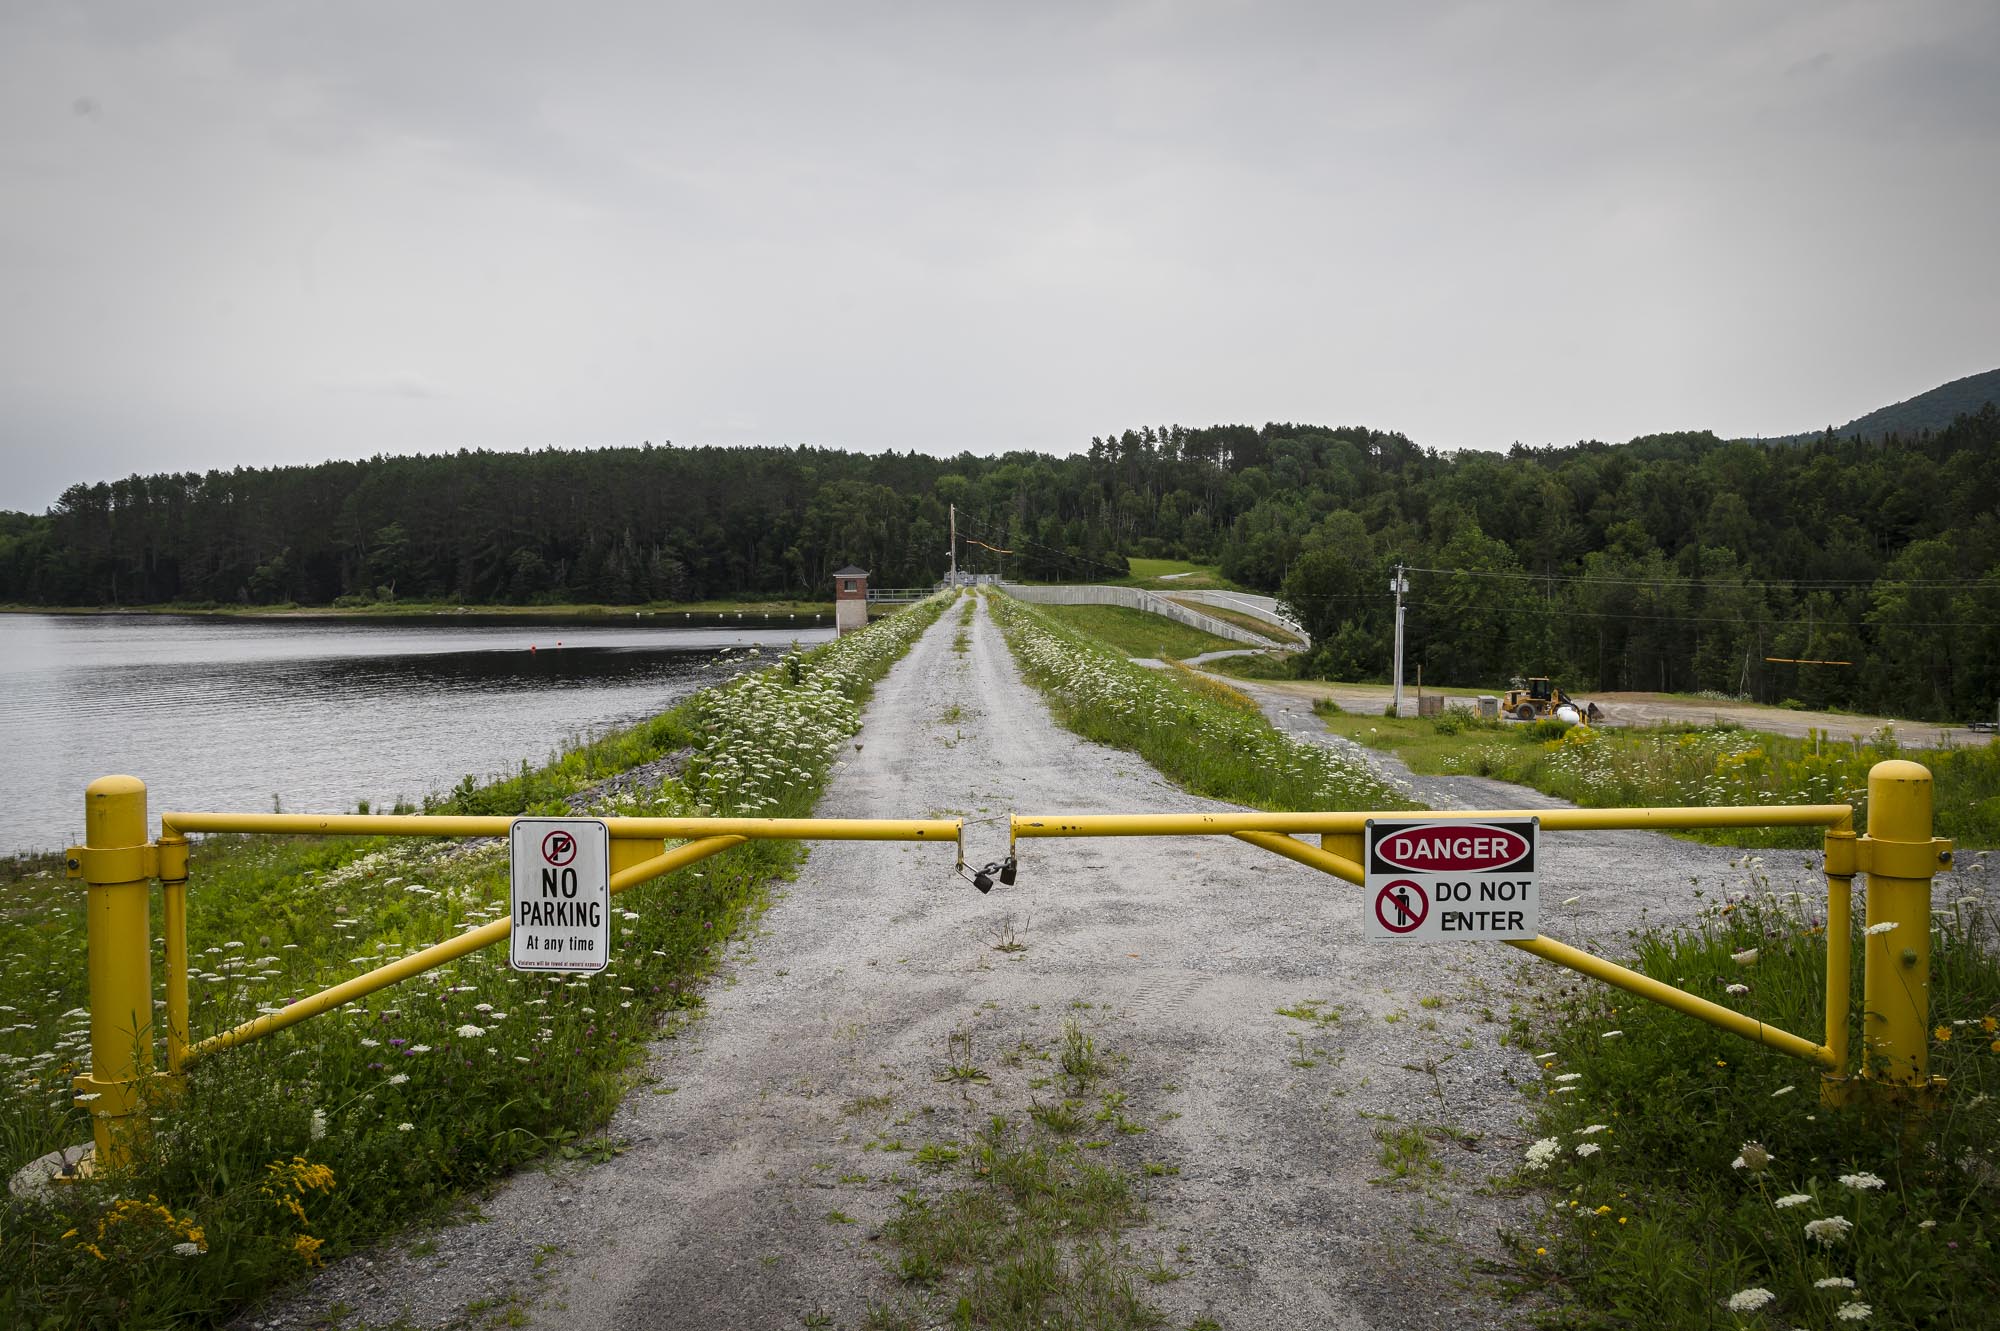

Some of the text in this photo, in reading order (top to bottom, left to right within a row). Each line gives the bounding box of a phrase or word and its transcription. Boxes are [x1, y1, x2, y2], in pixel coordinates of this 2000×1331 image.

[1395, 837, 1510, 860] DANGER
[542, 868, 577, 899] NO
[1435, 881, 1532, 901] DO NOT
[521, 901, 600, 928] PARKING
[1441, 911, 1525, 931] ENTER
[526, 935, 594, 952] At any time
